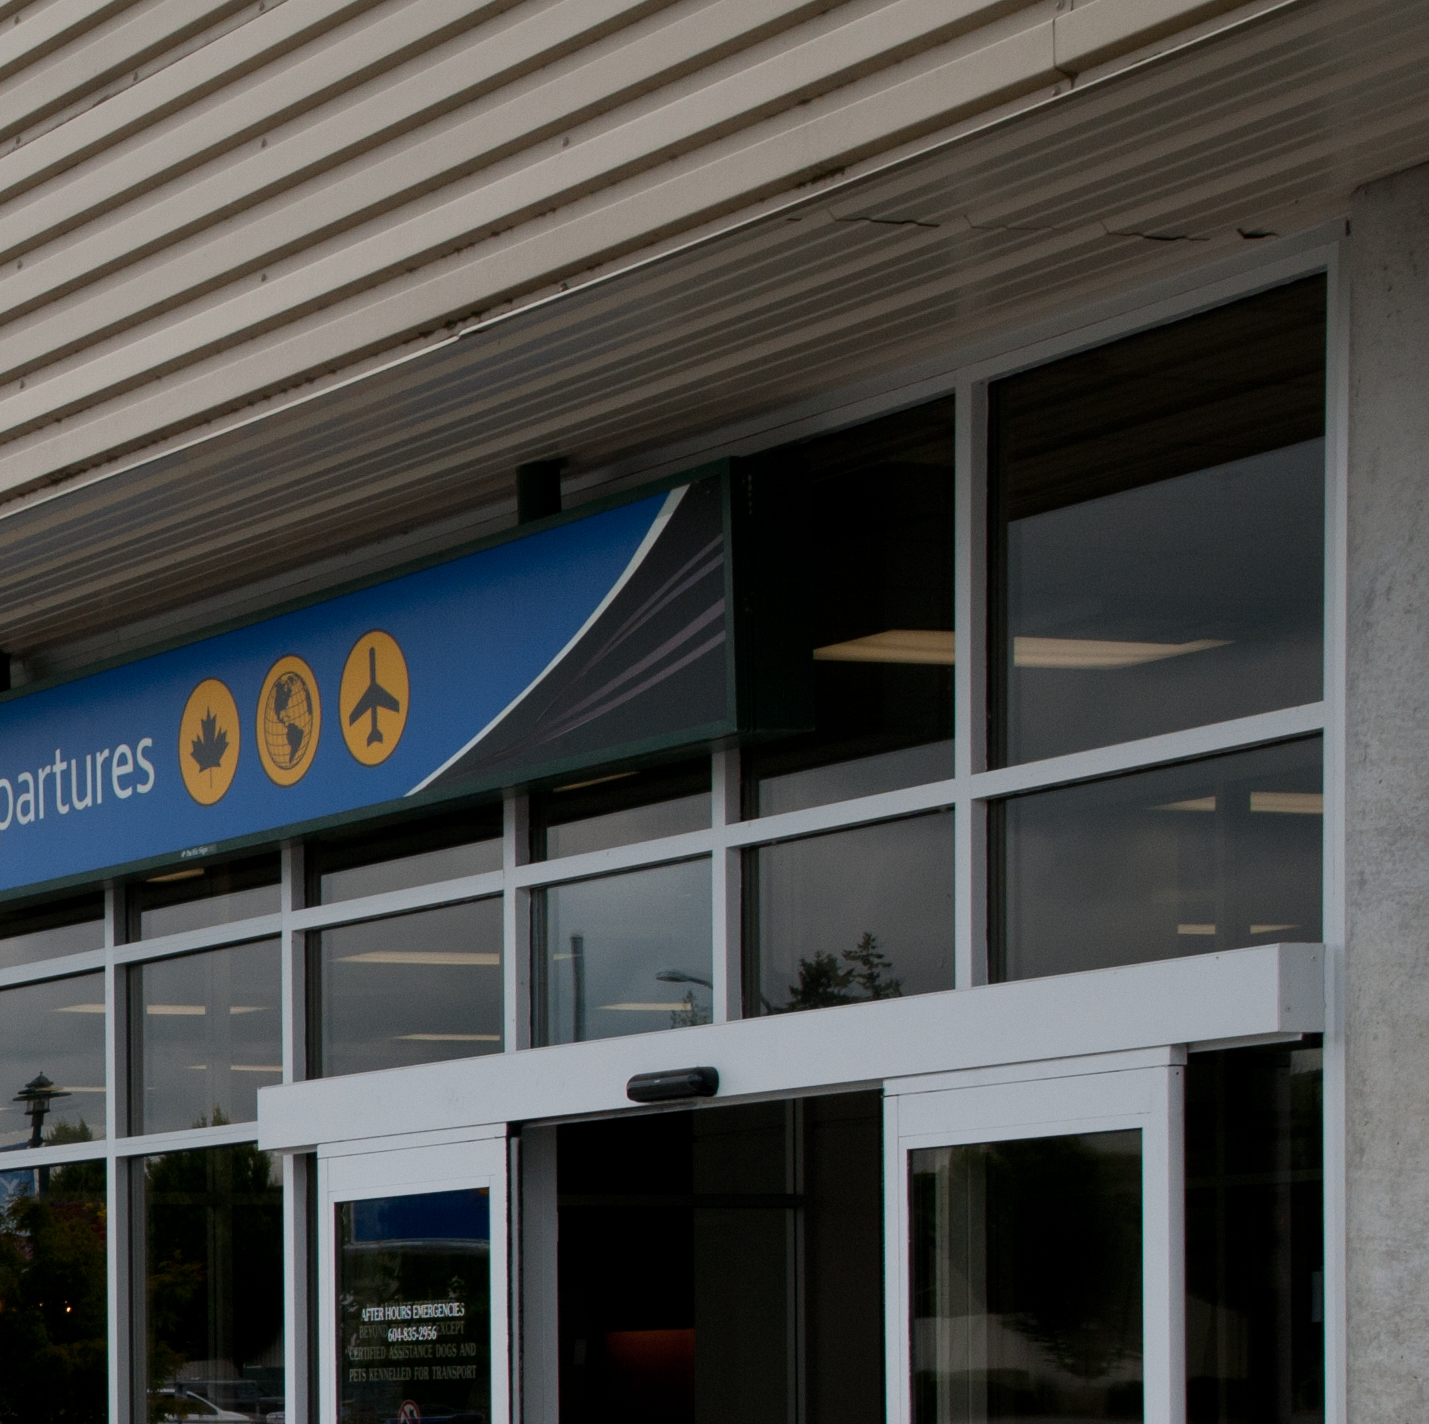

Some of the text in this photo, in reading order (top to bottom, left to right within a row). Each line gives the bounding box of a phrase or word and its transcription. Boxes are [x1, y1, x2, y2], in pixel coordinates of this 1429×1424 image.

[361, 1307, 384, 1321] AFTER
[385, 1305, 411, 1320] HOURS
[412, 1302, 465, 1319] EMERGENCIES
[359, 1324, 388, 1338] BEYOND
[436, 1321, 465, 1335] EXCEPT
[348, 1342, 476, 1360] CERTIFIED ASSISTANCE DOGS AND
[349, 1365, 477, 1382] PETS KENNELLED FOR TRANSPORT
